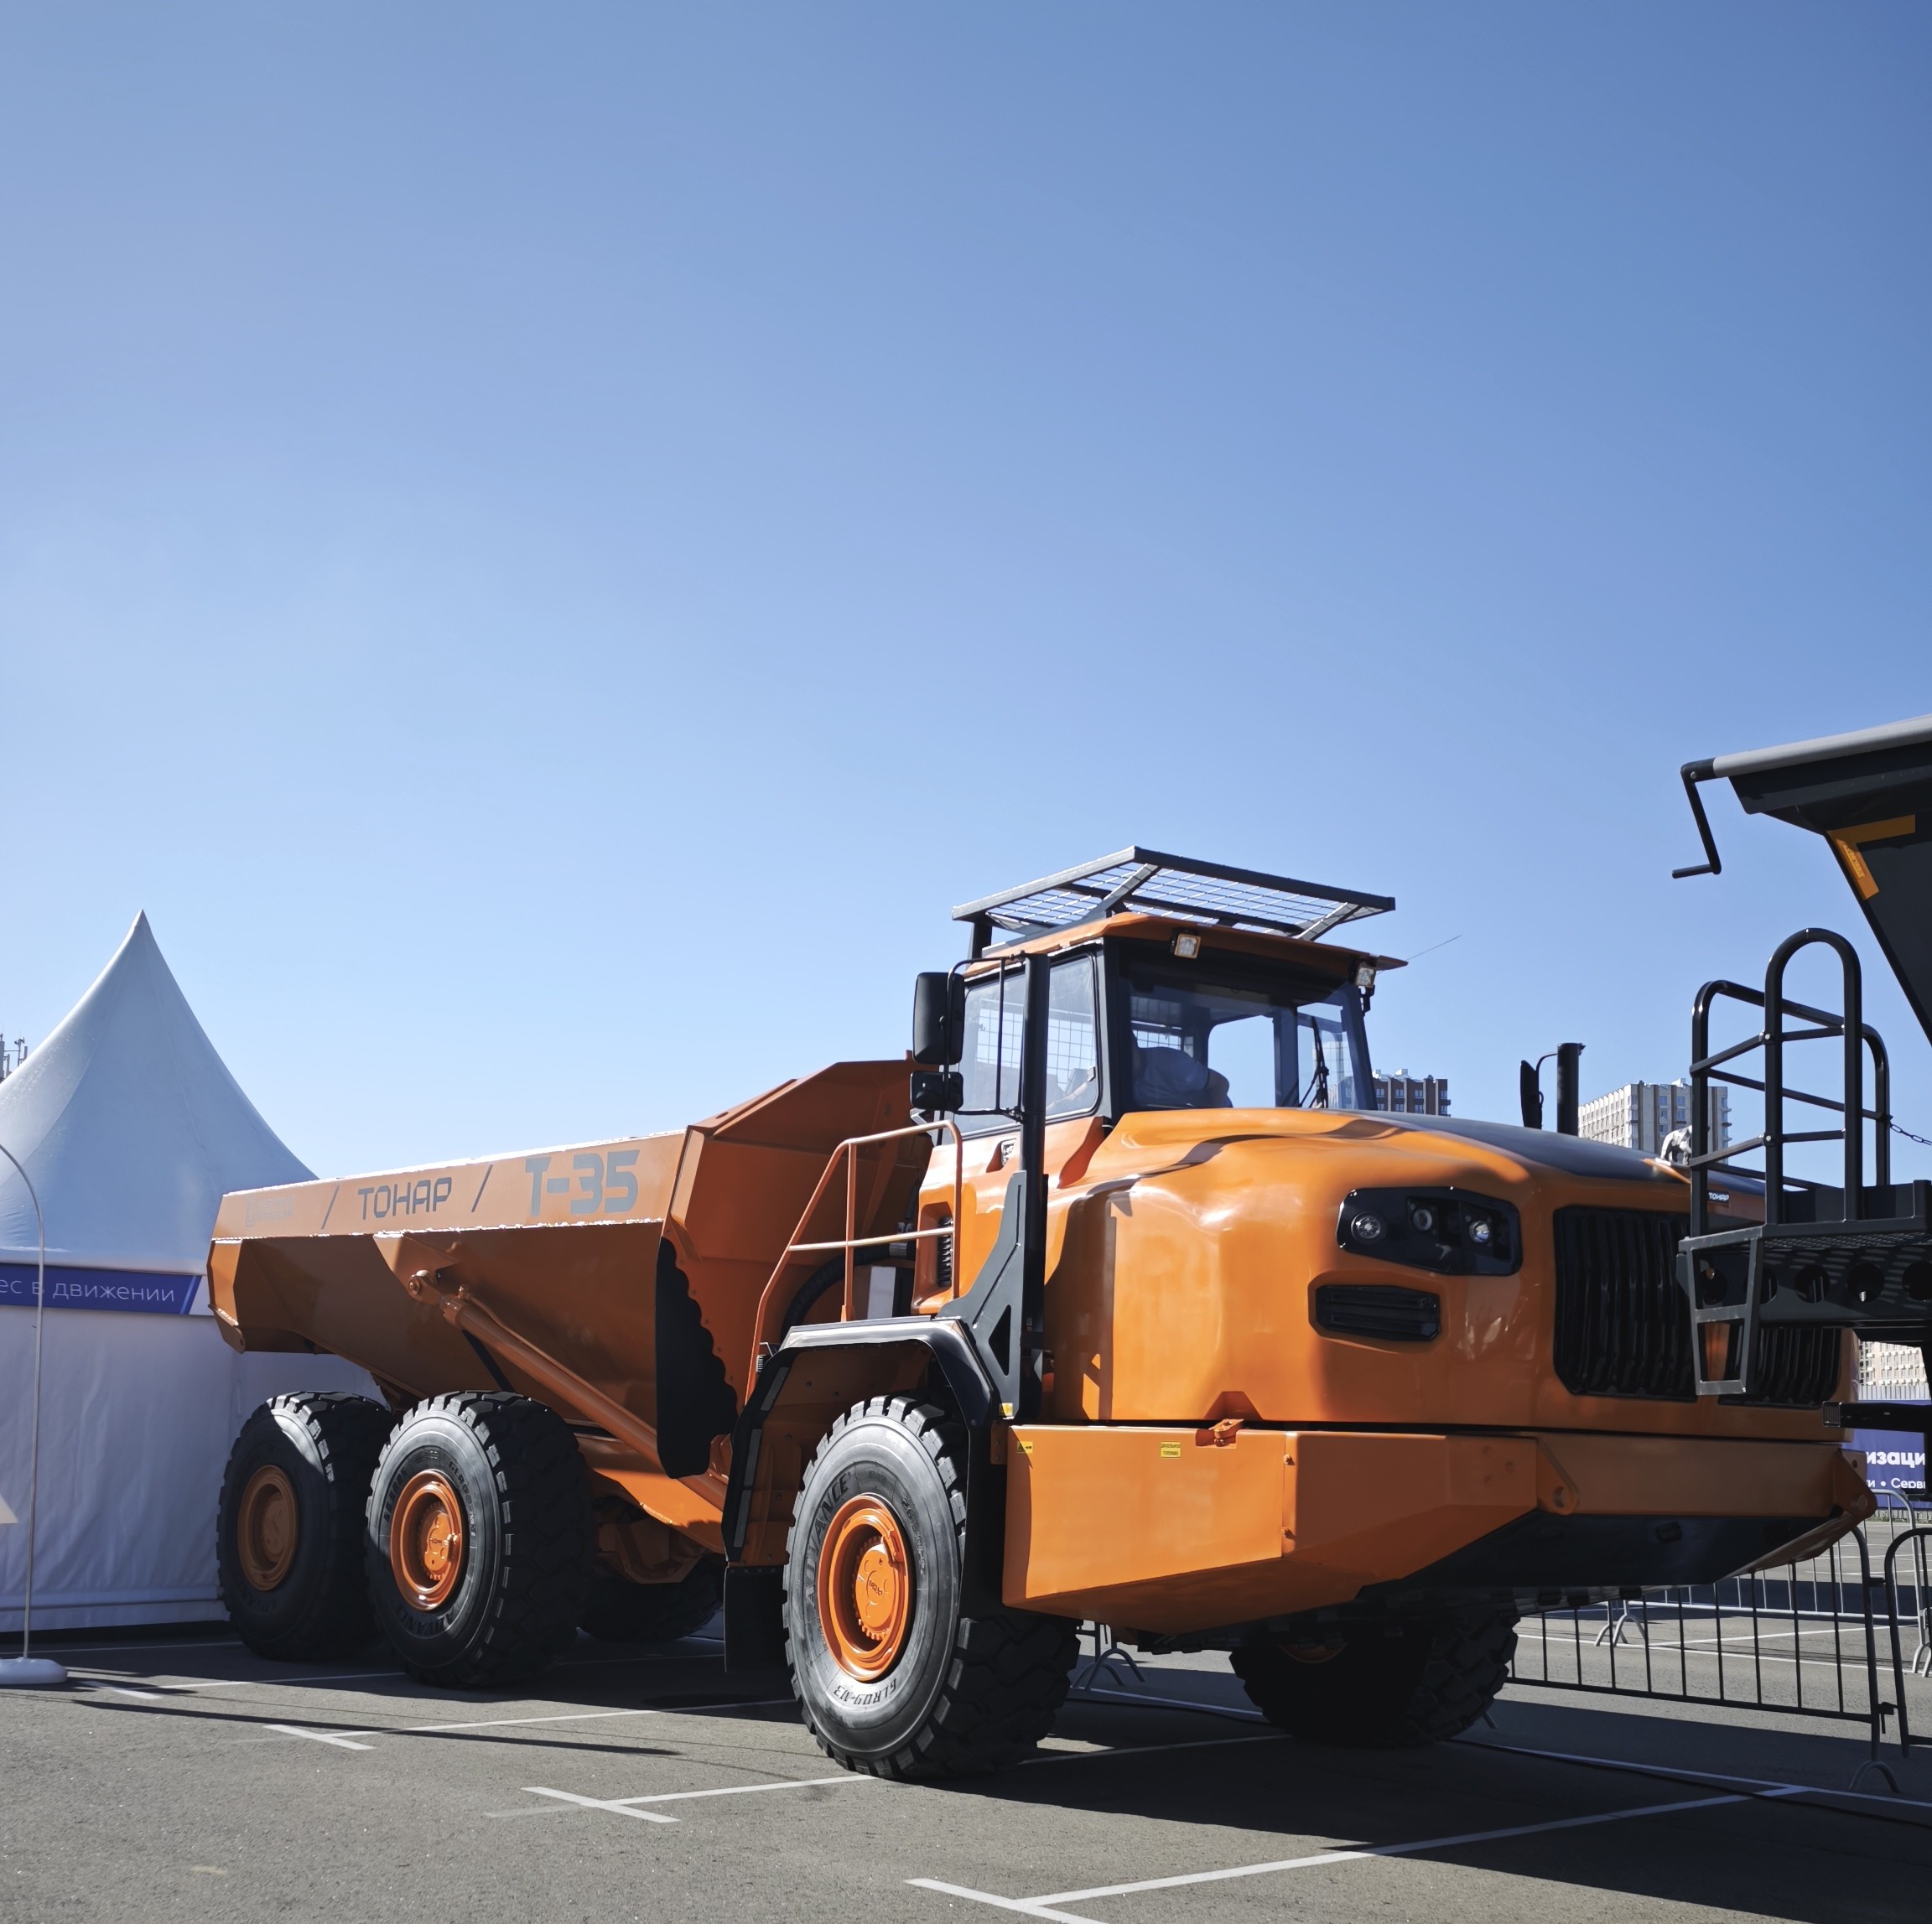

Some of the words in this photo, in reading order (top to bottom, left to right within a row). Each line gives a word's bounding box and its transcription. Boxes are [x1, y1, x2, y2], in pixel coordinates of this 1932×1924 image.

[358, 1177, 452, 1220] ТОНАР
[525, 1149, 640, 1216] Т-35
[52, 1283, 174, 1302] движении
[1866, 1451, 1925, 1469] изаци
